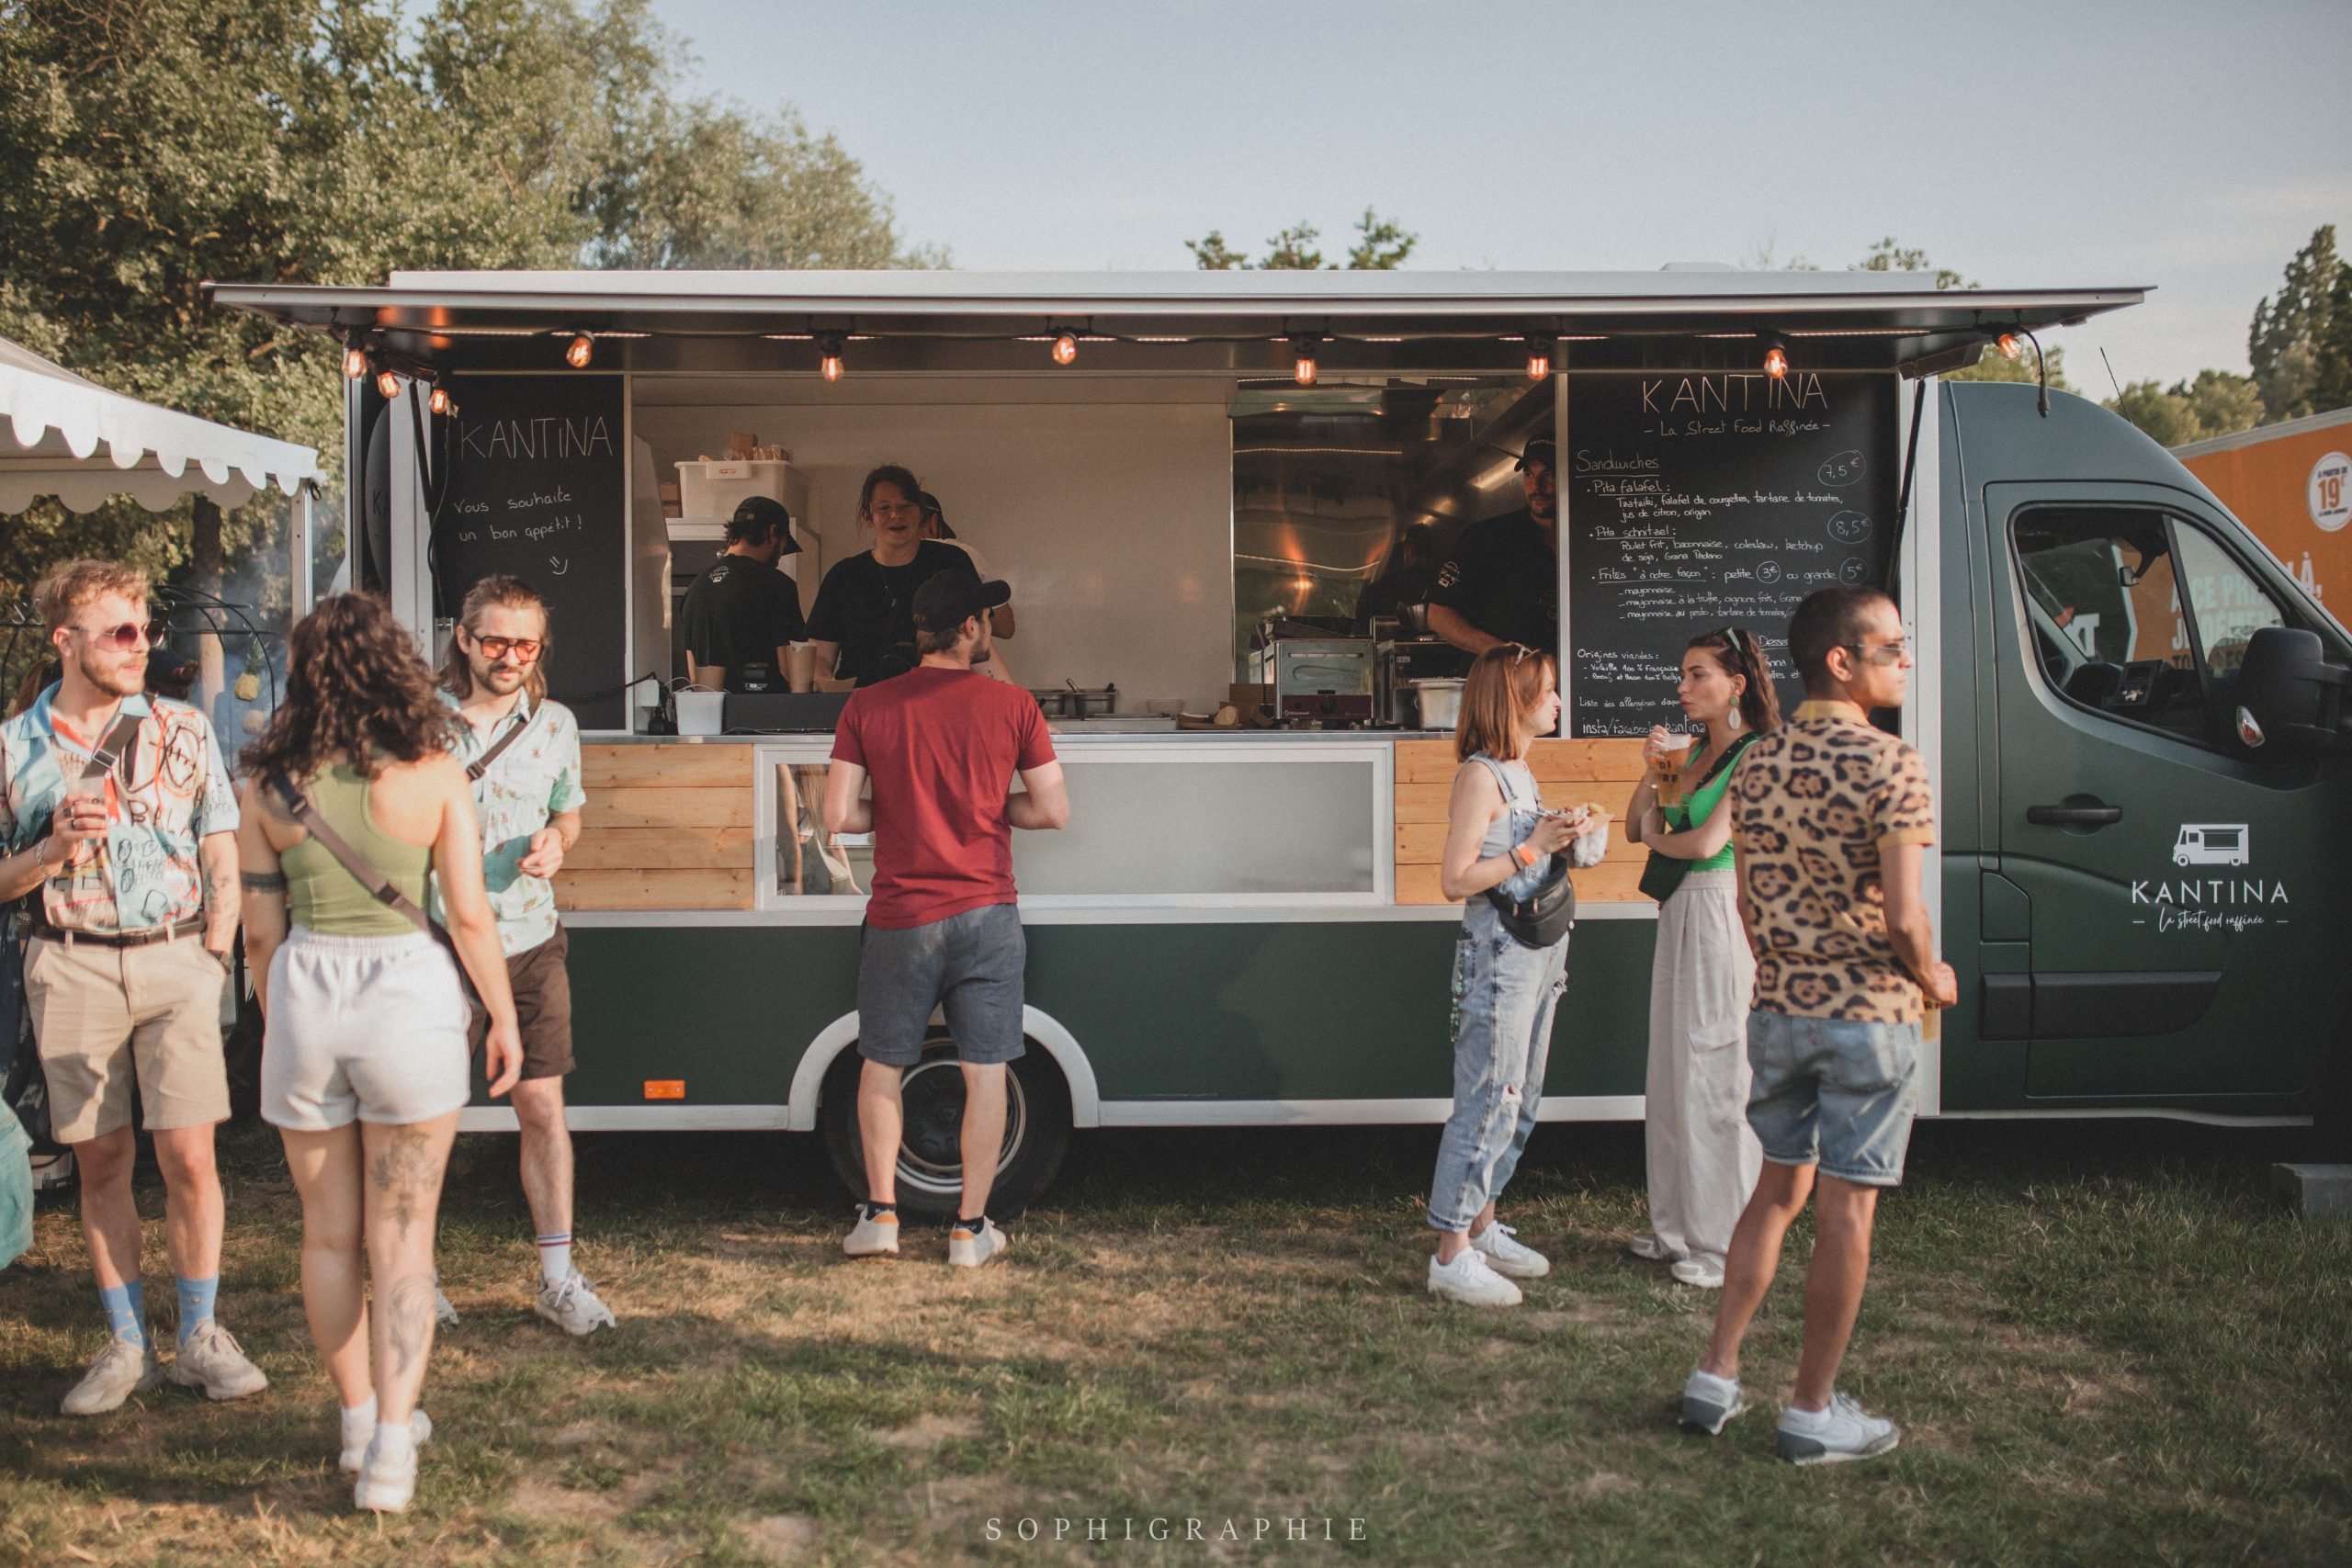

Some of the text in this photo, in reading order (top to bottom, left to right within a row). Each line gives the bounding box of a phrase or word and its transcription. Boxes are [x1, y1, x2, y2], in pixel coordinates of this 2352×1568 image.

[1643, 373, 1828, 413] KANTINA
[1661, 419, 1819, 437] La Street Food Raffinée
[460, 416, 613, 459] KANTINA
[1576, 449, 1659, 472] Sandwiches
[1592, 479, 1616, 493] Pita
[453, 485, 572, 513] Vous souhaite
[1661, 493, 1690, 506] falafel
[1693, 494, 1707, 505] de
[1754, 491, 1790, 503] tartare
[1794, 491, 1805, 502] de
[1621, 509, 1635, 524] jus
[1638, 508, 1650, 517] de
[1684, 508, 1712, 520] origan
[459, 532, 477, 542] un
[490, 525, 516, 540] bon
[1595, 525, 1615, 537] Pita
[1620, 540, 1646, 550] Poulet
[1785, 538, 1824, 552] ketchup
[1622, 553, 1635, 562] de
[1665, 552, 1689, 560] Grana
[1693, 549, 1724, 559] Padano
[1599, 568, 1627, 580] Frites
[1649, 569, 1673, 580] notre
[1724, 569, 1755, 583] petite
[1804, 570, 1838, 584] grande
[1687, 593, 1695, 604] la
[1716, 605, 1746, 617] tartare
[1746, 606, 1757, 616] de
[1758, 635, 1789, 648] Desser
[1577, 649, 1618, 663] Origines
[1589, 662, 1618, 671] Volaille
[1622, 663, 1635, 671] 100
[1645, 664, 1679, 674] Française
[1579, 696, 1599, 707] Liste
[2132, 879, 2289, 904] KANTINA
[2159, 906, 2265, 933] La street food raffinée
